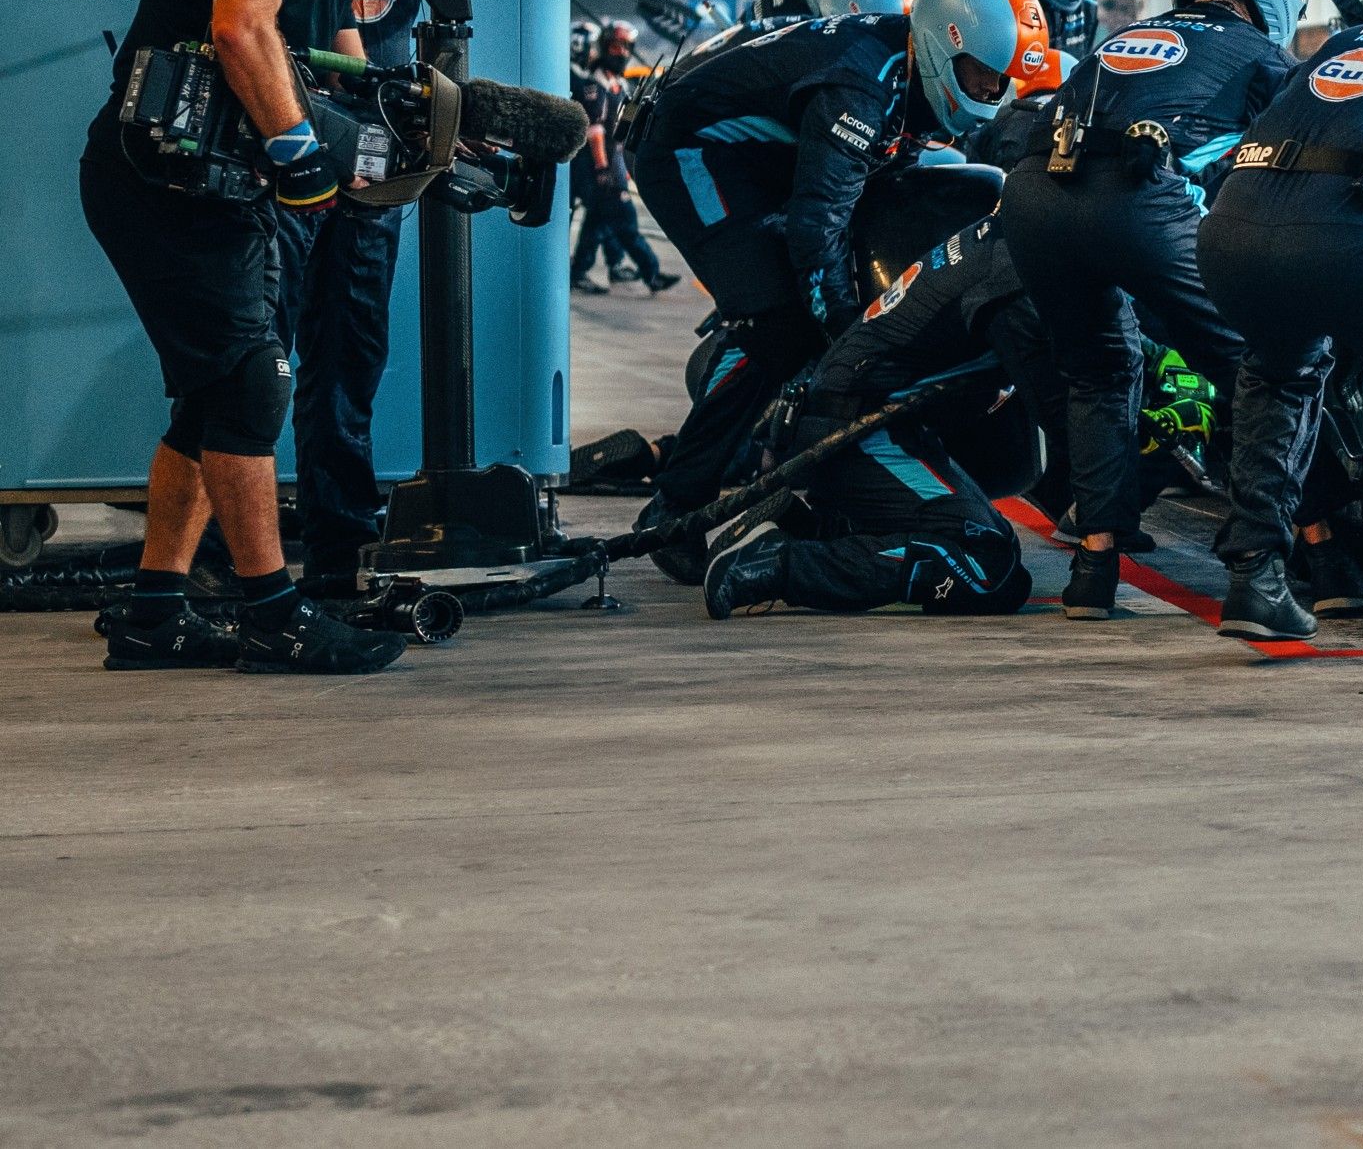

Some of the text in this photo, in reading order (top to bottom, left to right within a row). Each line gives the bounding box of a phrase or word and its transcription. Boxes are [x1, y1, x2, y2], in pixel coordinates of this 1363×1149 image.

[949, 25, 962, 48] BELL
[1023, 52, 1043, 66] Gulf
[1101, 40, 1181, 60] Gulf
[838, 112, 876, 138] Acronis
[831, 123, 870, 151] PIRELLI
[1235, 145, 1274, 165] OMP
